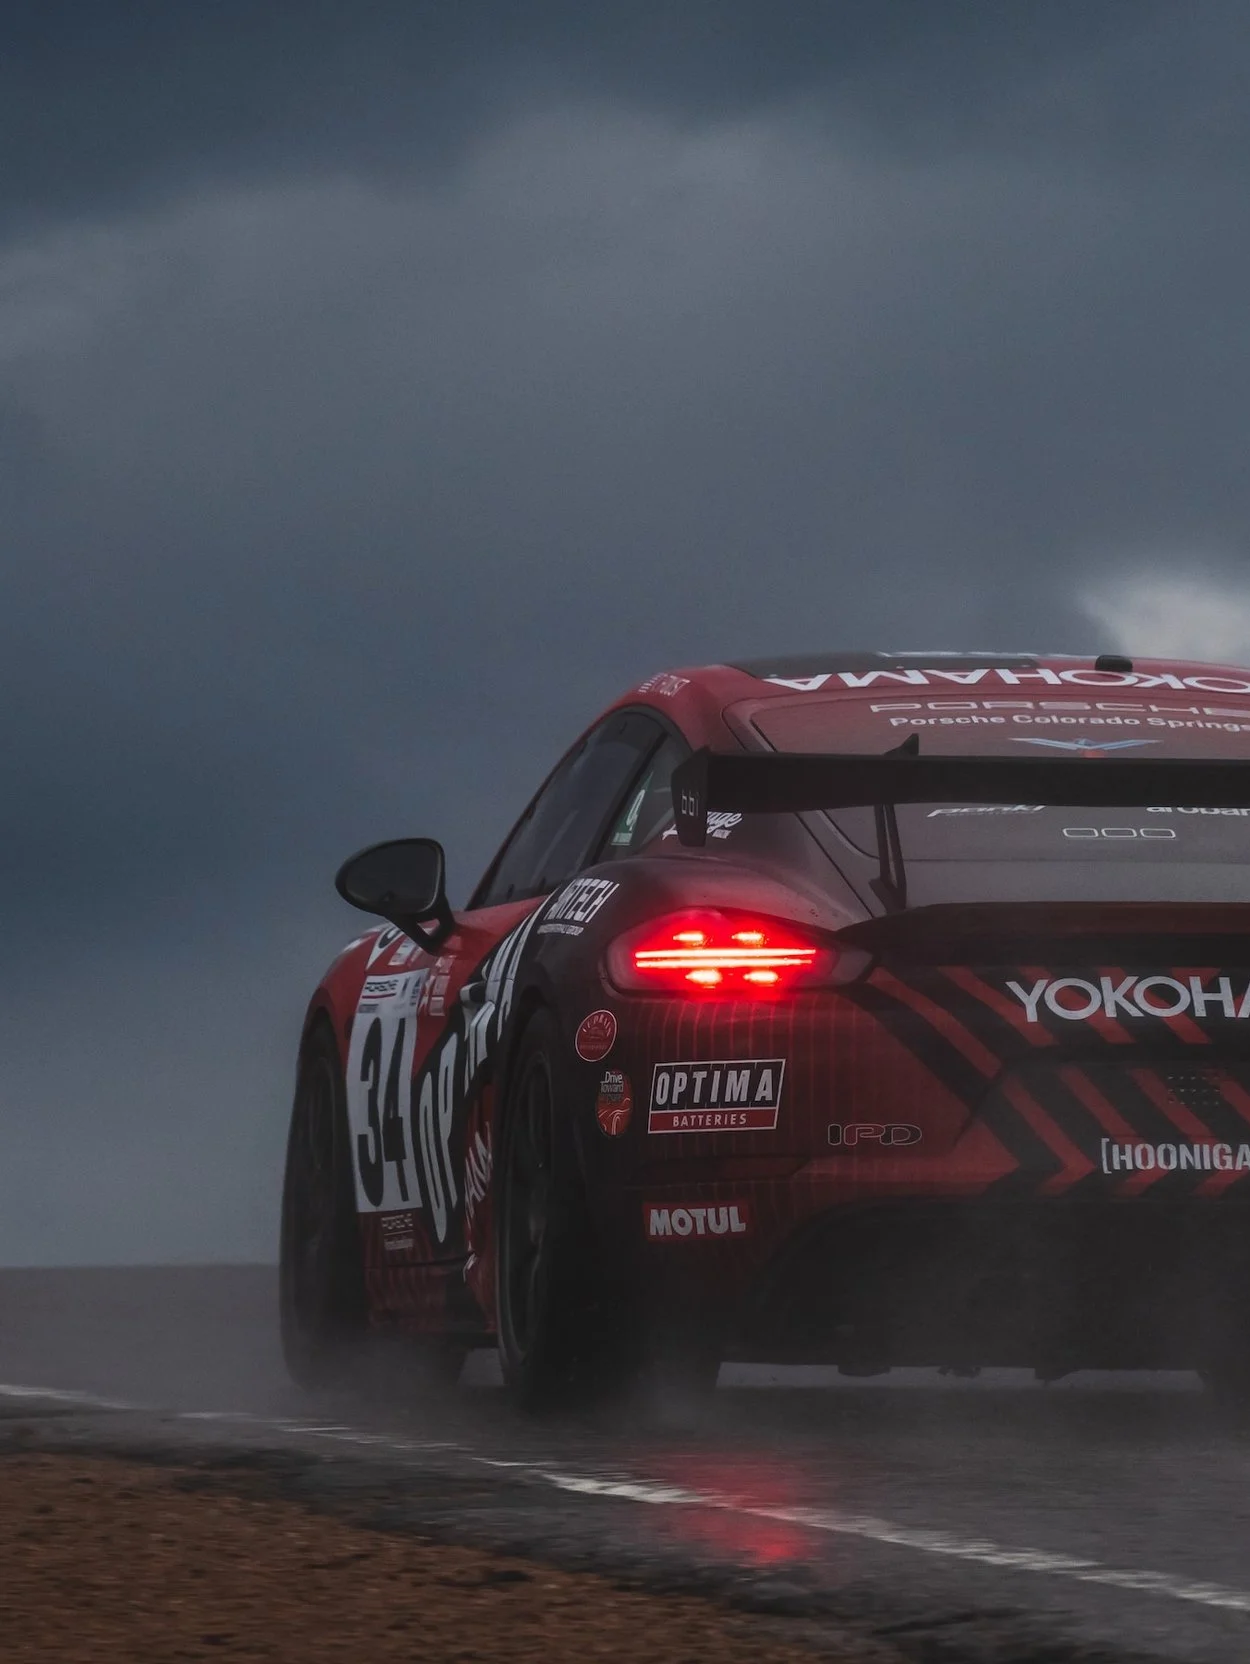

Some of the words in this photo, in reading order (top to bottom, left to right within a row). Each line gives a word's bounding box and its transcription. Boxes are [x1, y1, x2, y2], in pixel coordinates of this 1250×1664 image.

[889, 714, 1006, 728] Porsche
[1012, 713, 1142, 727] Colorado
[655, 1068, 775, 1106] OPTIMA
[357, 1016, 413, 1209] 34
[672, 1112, 748, 1128] BATTERIES
[827, 1122, 923, 1146] IPD
[650, 1206, 747, 1236] MOTUL
